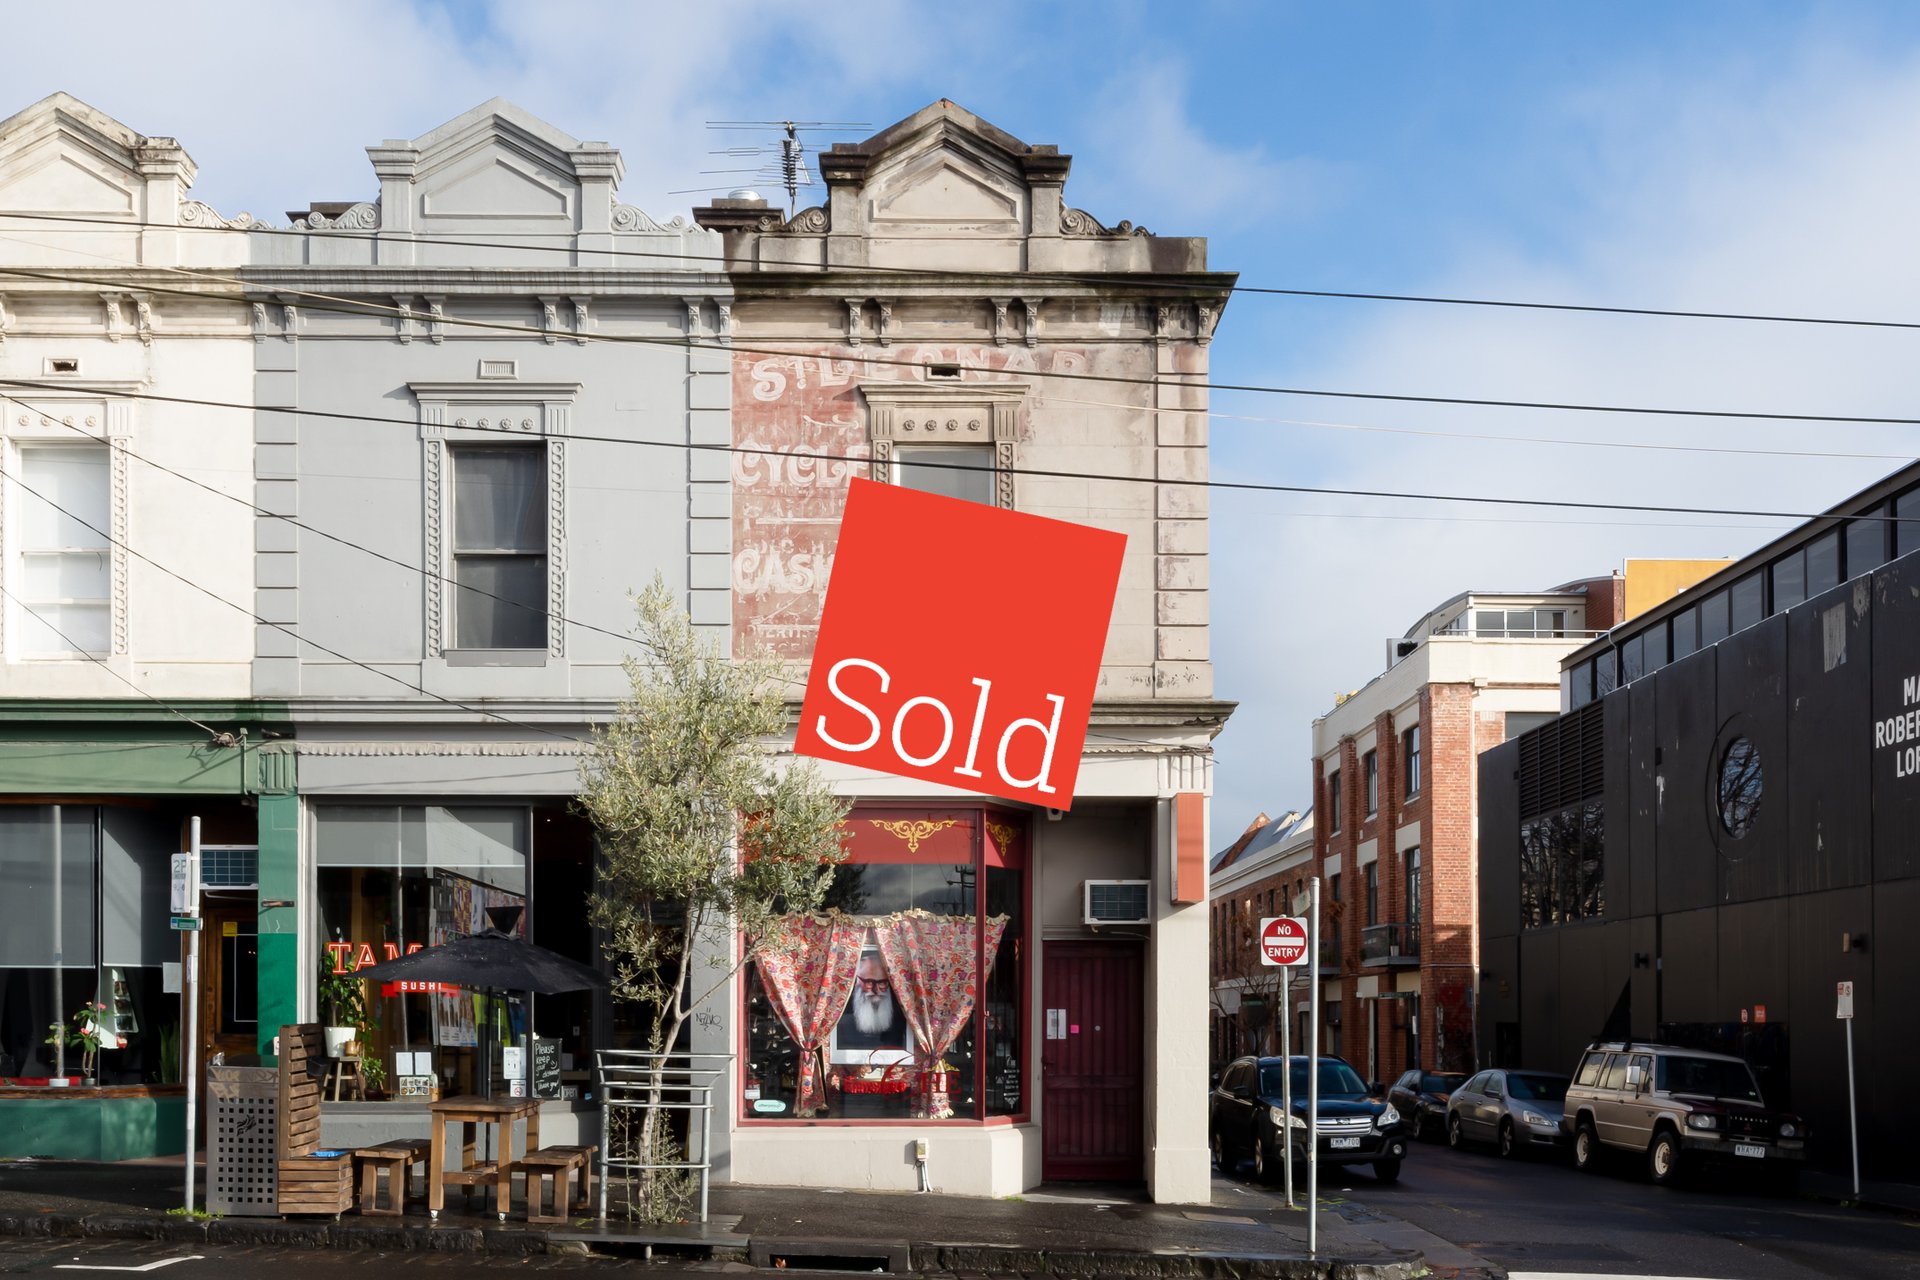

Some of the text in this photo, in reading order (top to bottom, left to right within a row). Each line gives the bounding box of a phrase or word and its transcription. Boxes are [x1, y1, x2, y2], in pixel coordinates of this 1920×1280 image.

[1277, 925, 1292, 935] NO
[1268, 947, 1300, 957] ENTRY
[401, 981, 441, 990] SUSHI
[535, 1043, 555, 1055] Please
